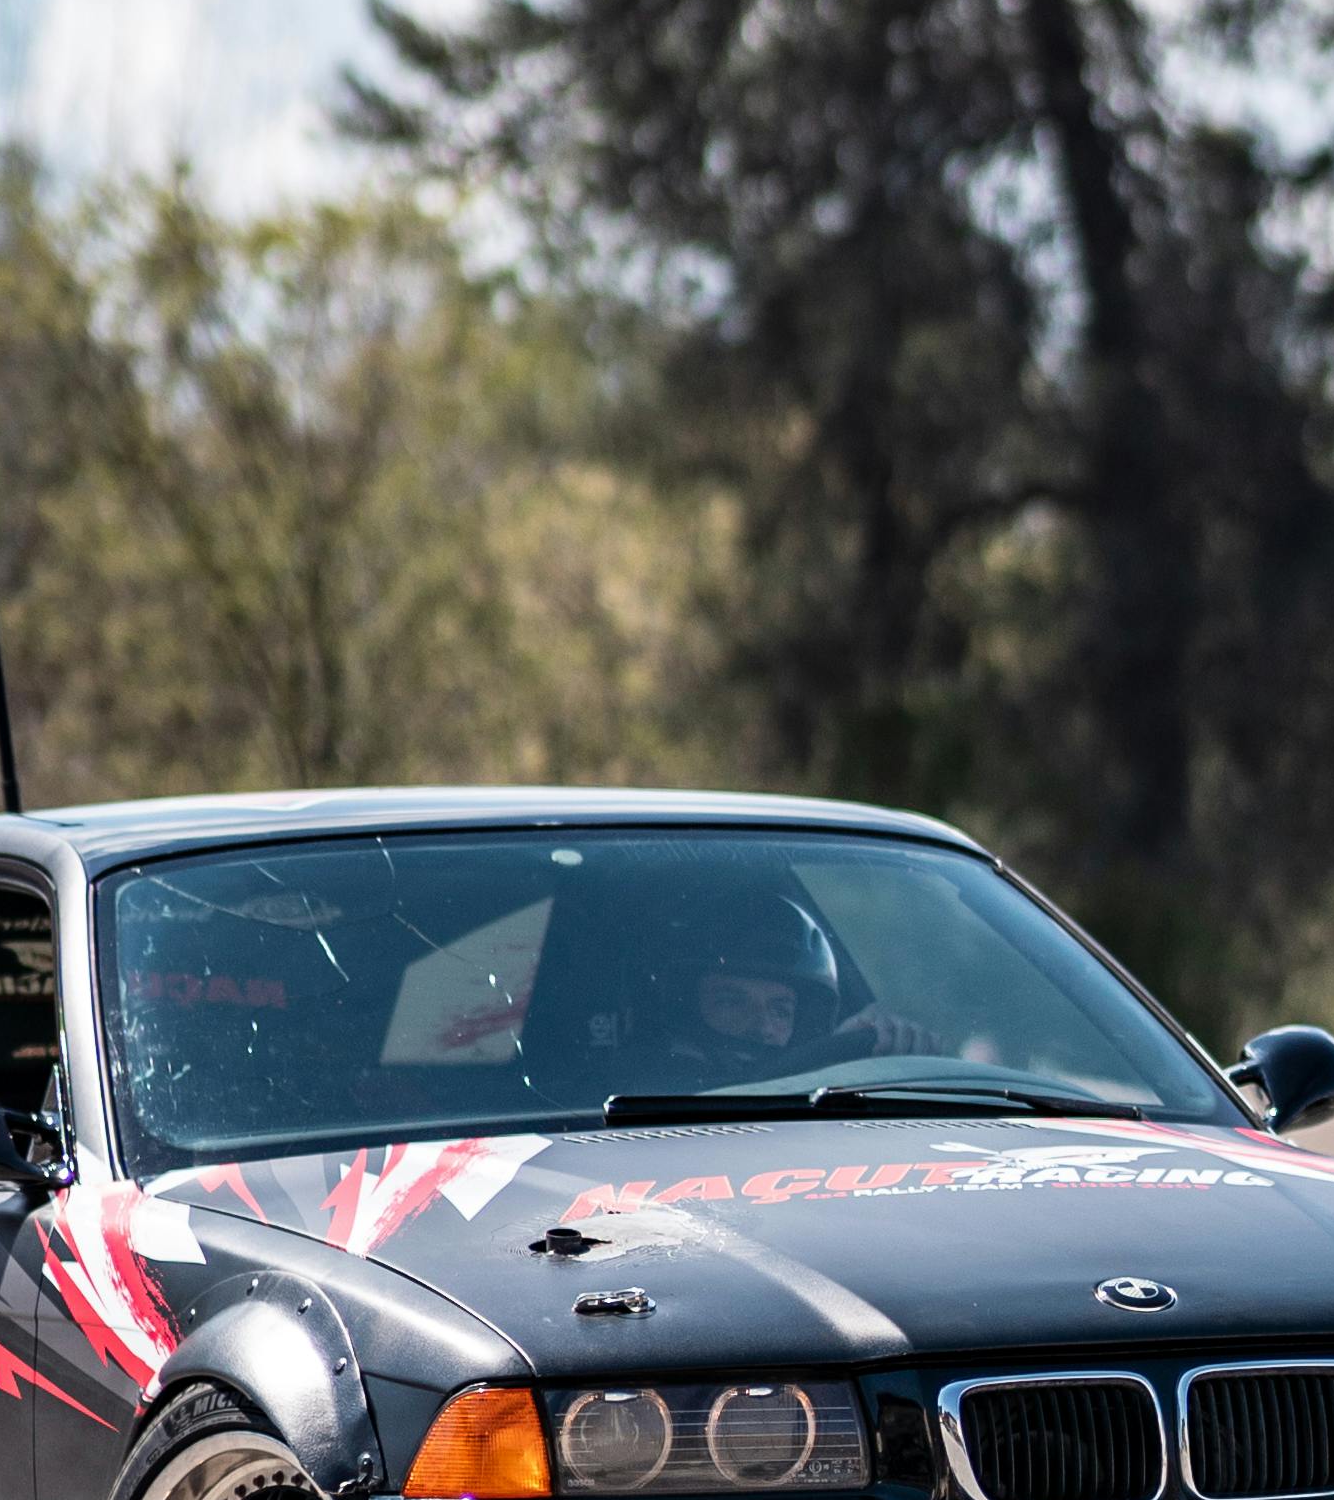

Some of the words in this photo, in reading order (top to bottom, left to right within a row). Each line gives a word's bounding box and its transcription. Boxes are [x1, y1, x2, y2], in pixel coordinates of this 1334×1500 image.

[558, 1161, 988, 1223] NAÇUT
[963, 1166, 1275, 1188] RACING
[853, 1185, 938, 1197] RALLY
[945, 1183, 1023, 1192] TEAM
